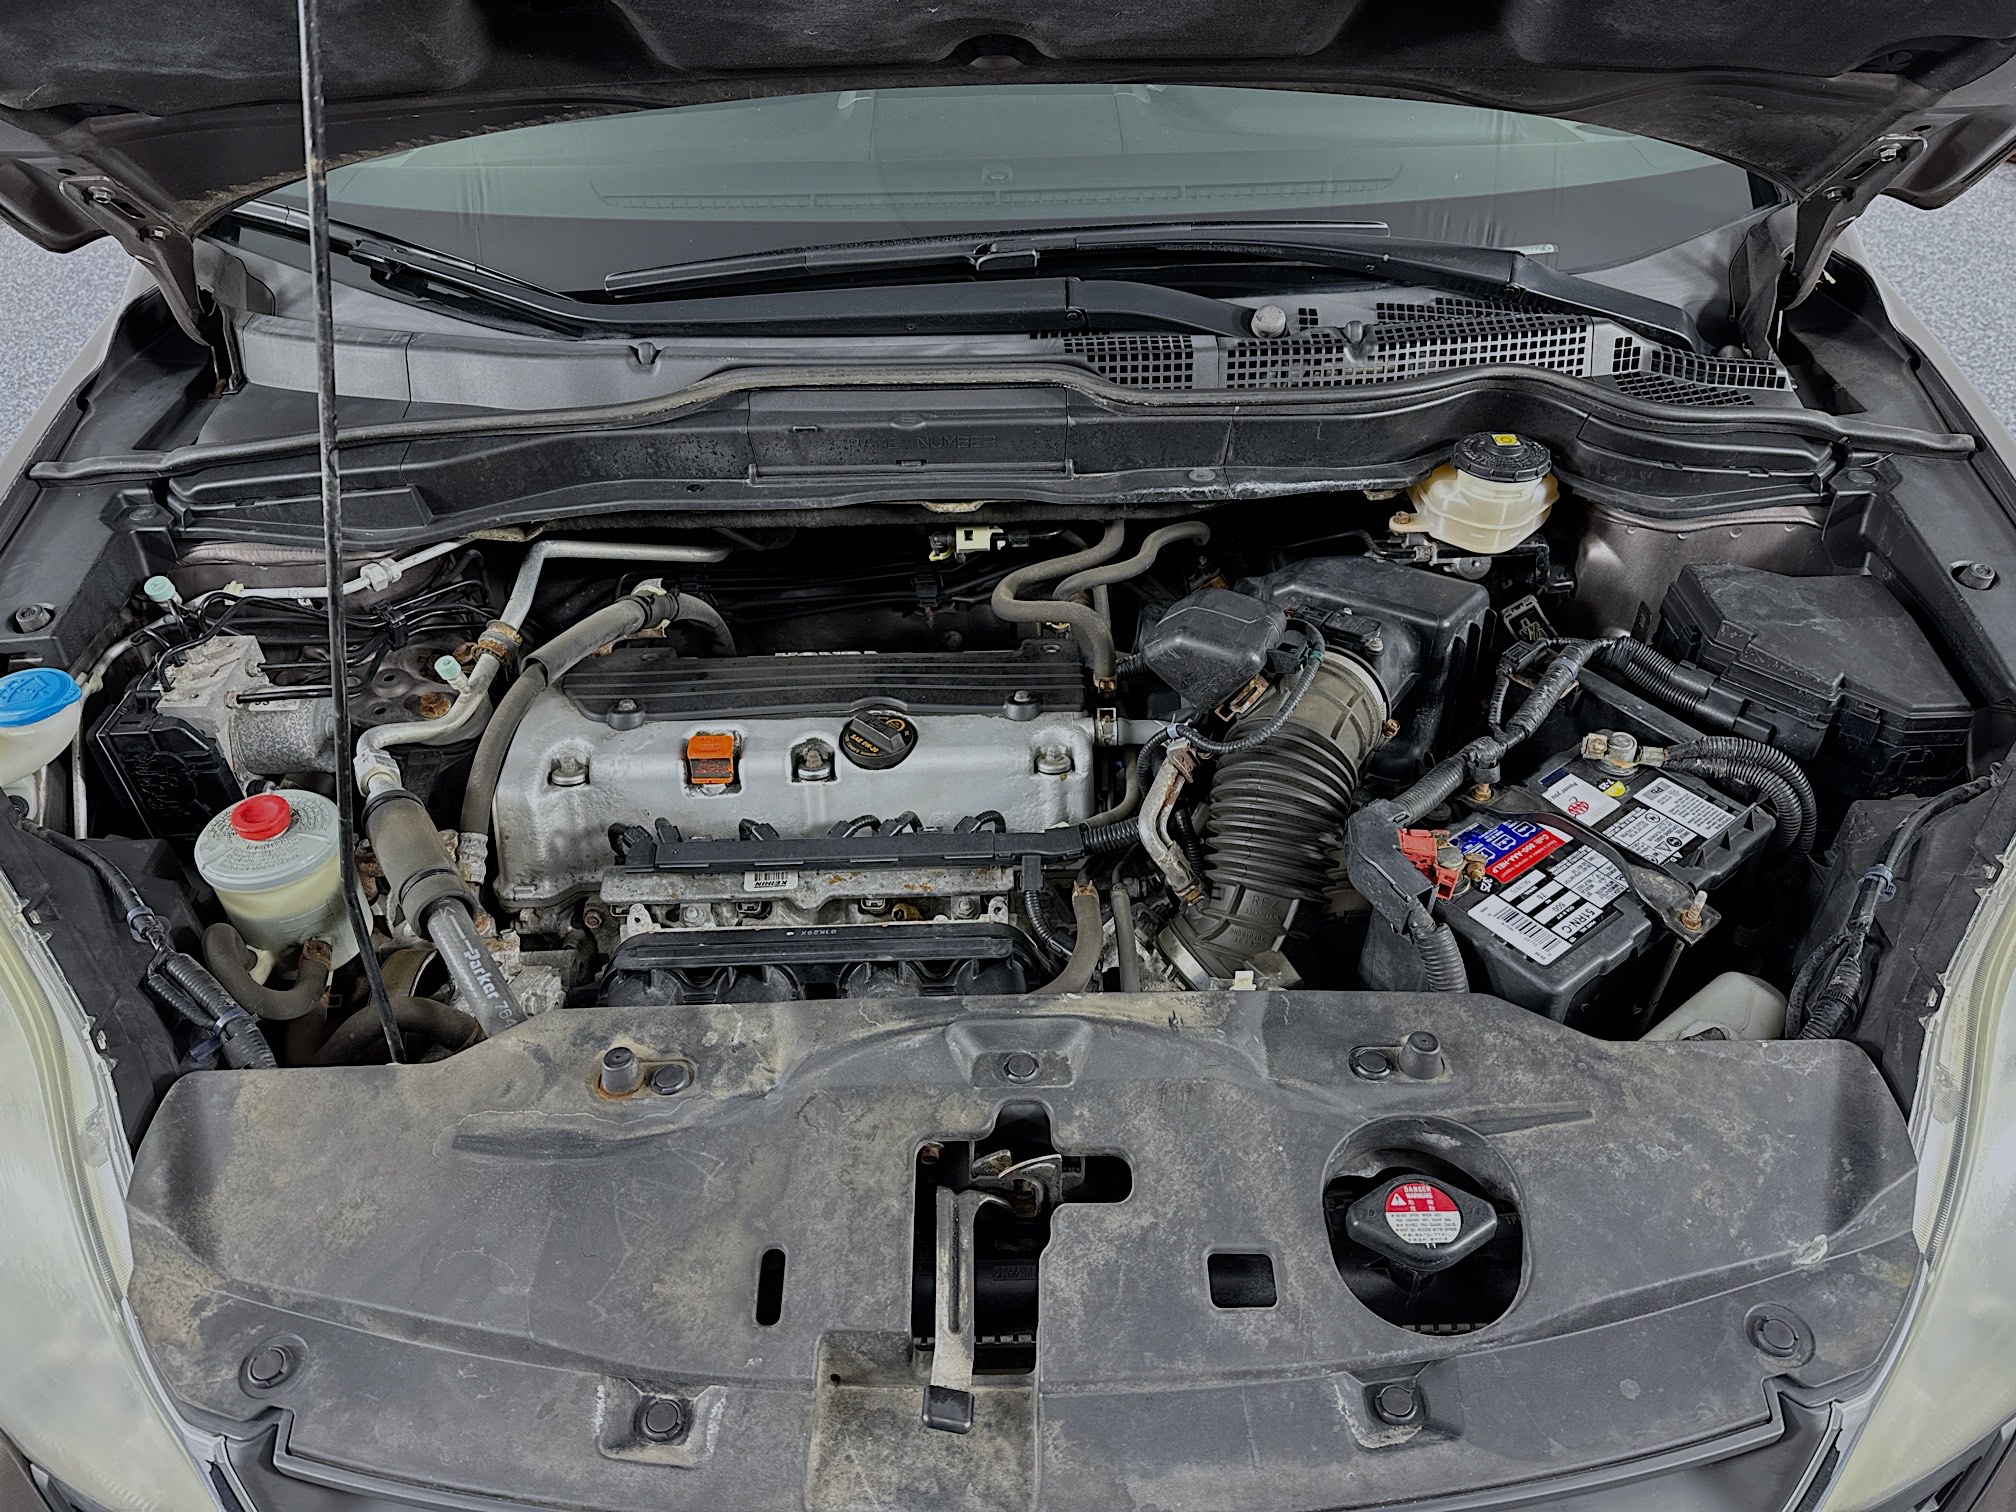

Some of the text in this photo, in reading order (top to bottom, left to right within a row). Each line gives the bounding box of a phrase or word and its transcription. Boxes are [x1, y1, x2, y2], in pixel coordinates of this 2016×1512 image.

[917, 435, 997, 449] NUMBER
[850, 734, 862, 742] SAE
[1549, 781, 1578, 799] Power you
[1650, 786, 1664, 795] Pb
[1489, 842, 1536, 874] 800-AAA-HELP
[1550, 901, 1566, 912] 500
[1559, 907, 1597, 933] 51RN-C
[463, 948, 500, 1000] Parker
